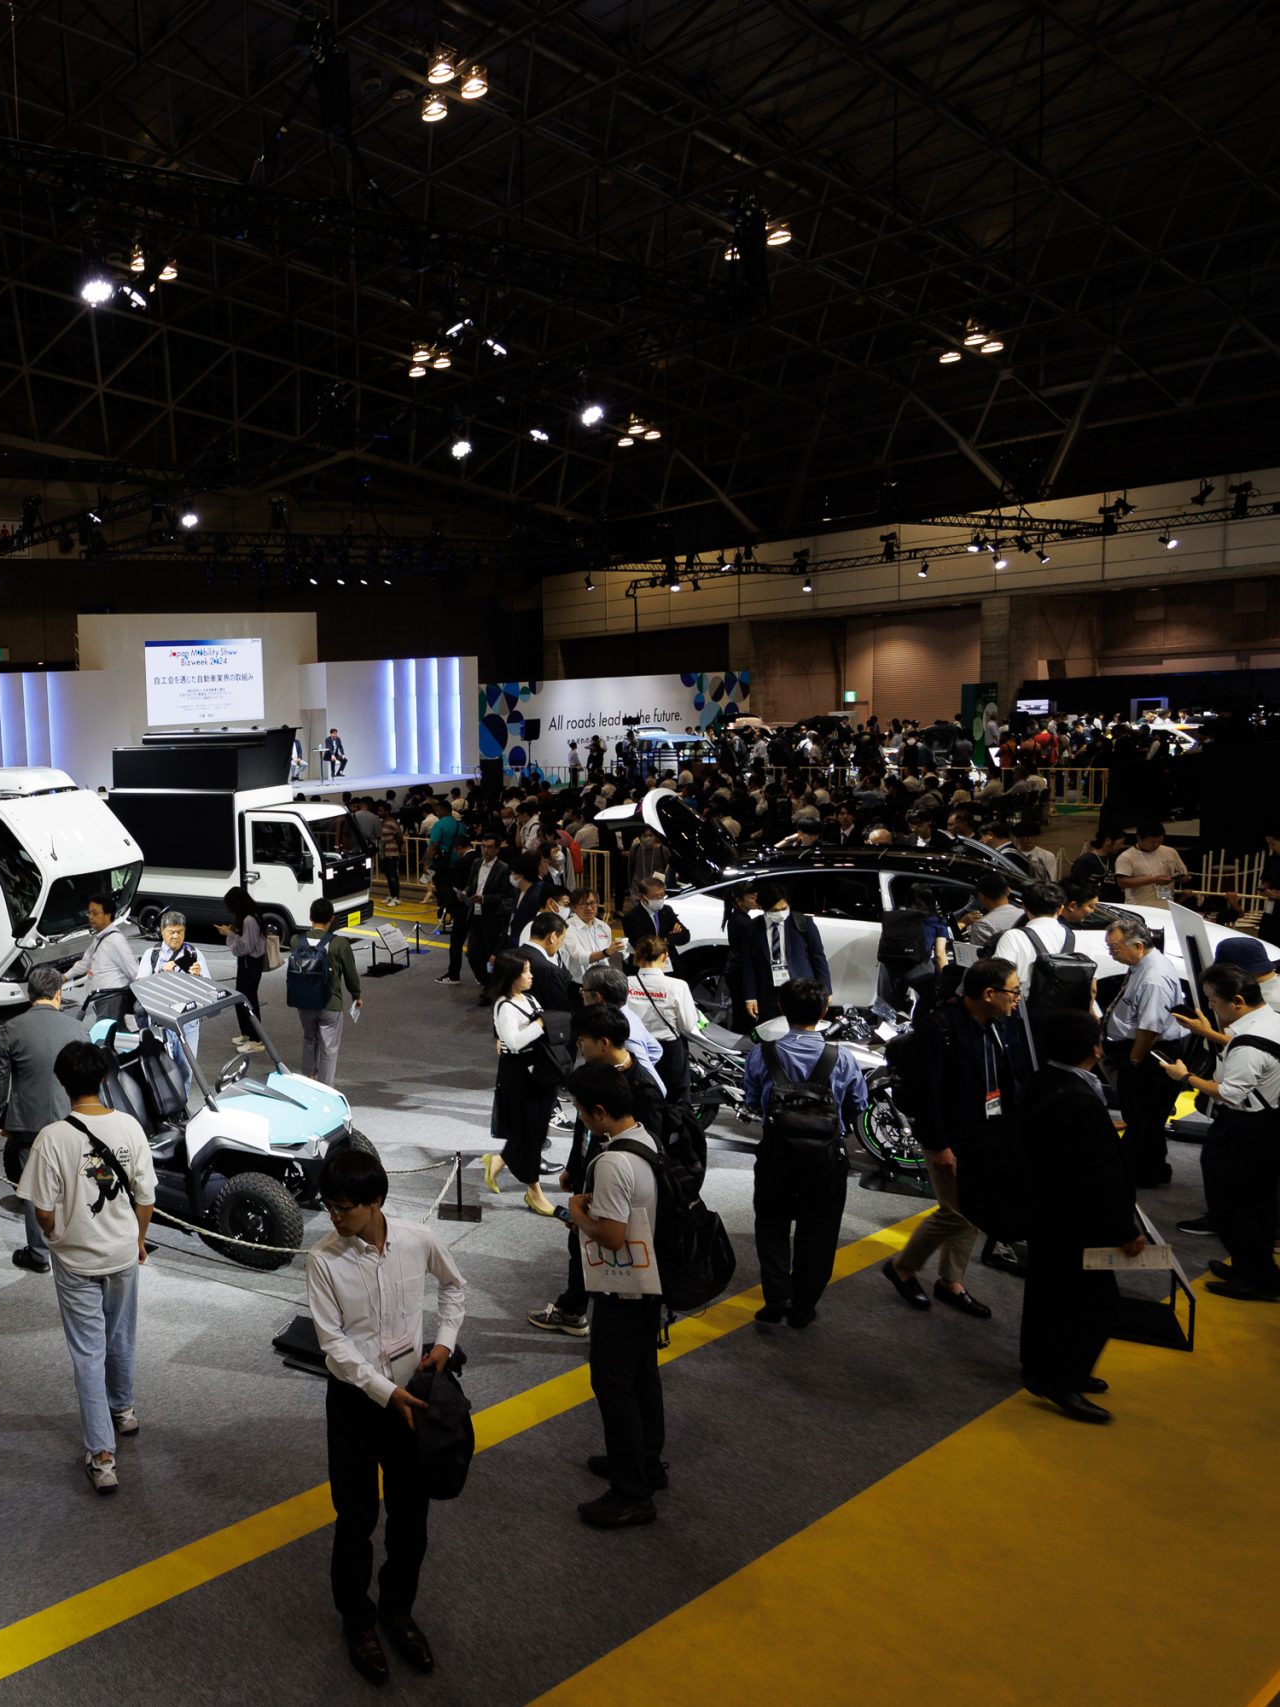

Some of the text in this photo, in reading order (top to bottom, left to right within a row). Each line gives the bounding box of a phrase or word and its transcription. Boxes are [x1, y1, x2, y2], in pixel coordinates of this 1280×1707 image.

[169, 648, 238, 659] Japan Mobility Show
[210, 657, 227, 666] 2024
[548, 714, 564, 731] All
[566, 712, 596, 729] roads
[598, 710, 622, 727] lead
[653, 707, 683, 723] future.
